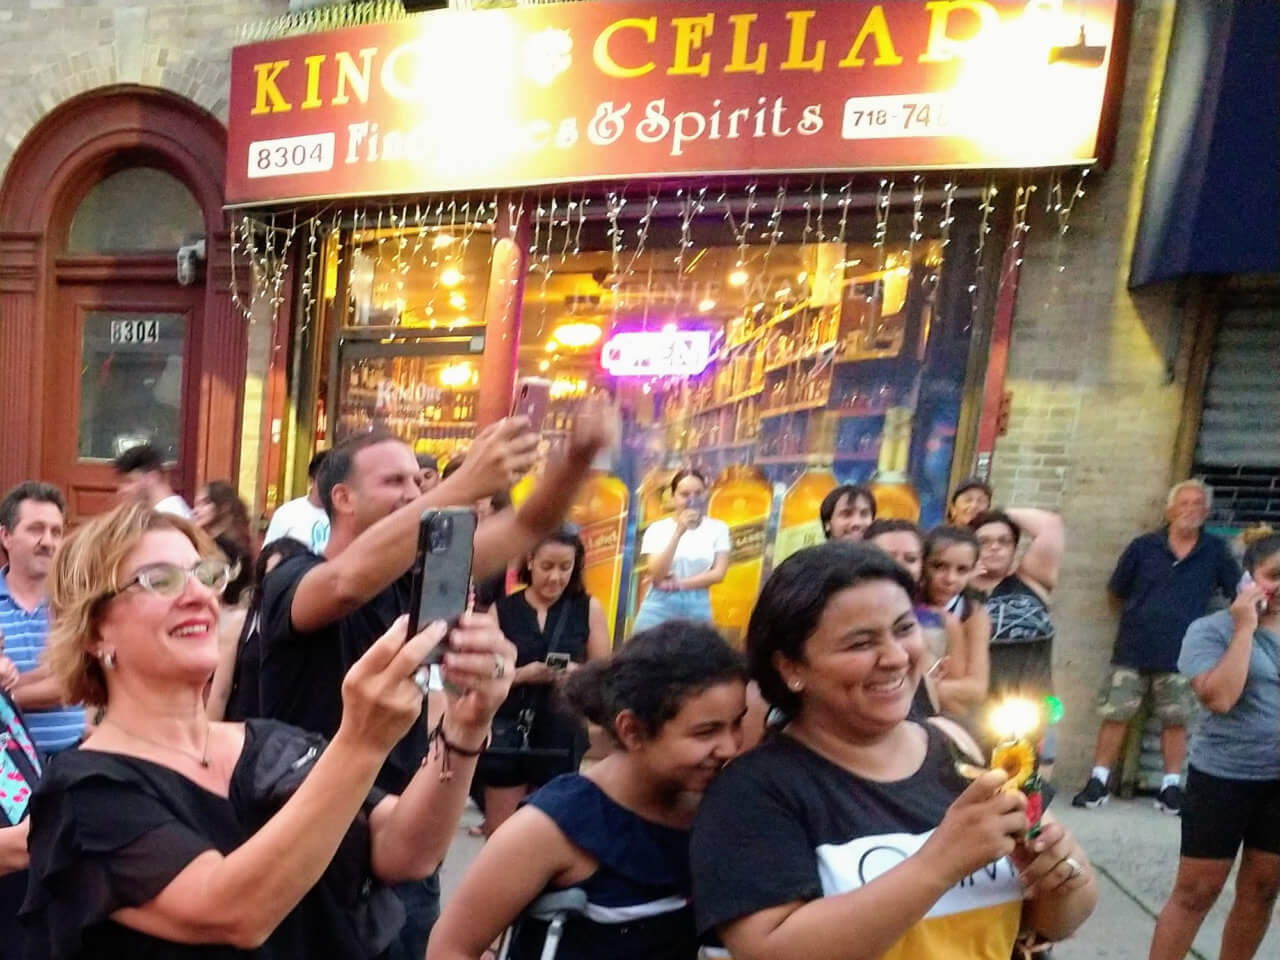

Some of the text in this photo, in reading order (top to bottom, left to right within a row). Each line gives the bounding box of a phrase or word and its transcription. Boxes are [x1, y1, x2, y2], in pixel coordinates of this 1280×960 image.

[588, 101, 631, 146] &
[636, 96, 824, 156] Spirits
[257, 142, 323, 170] 8304
[114, 320, 157, 342] 8304
